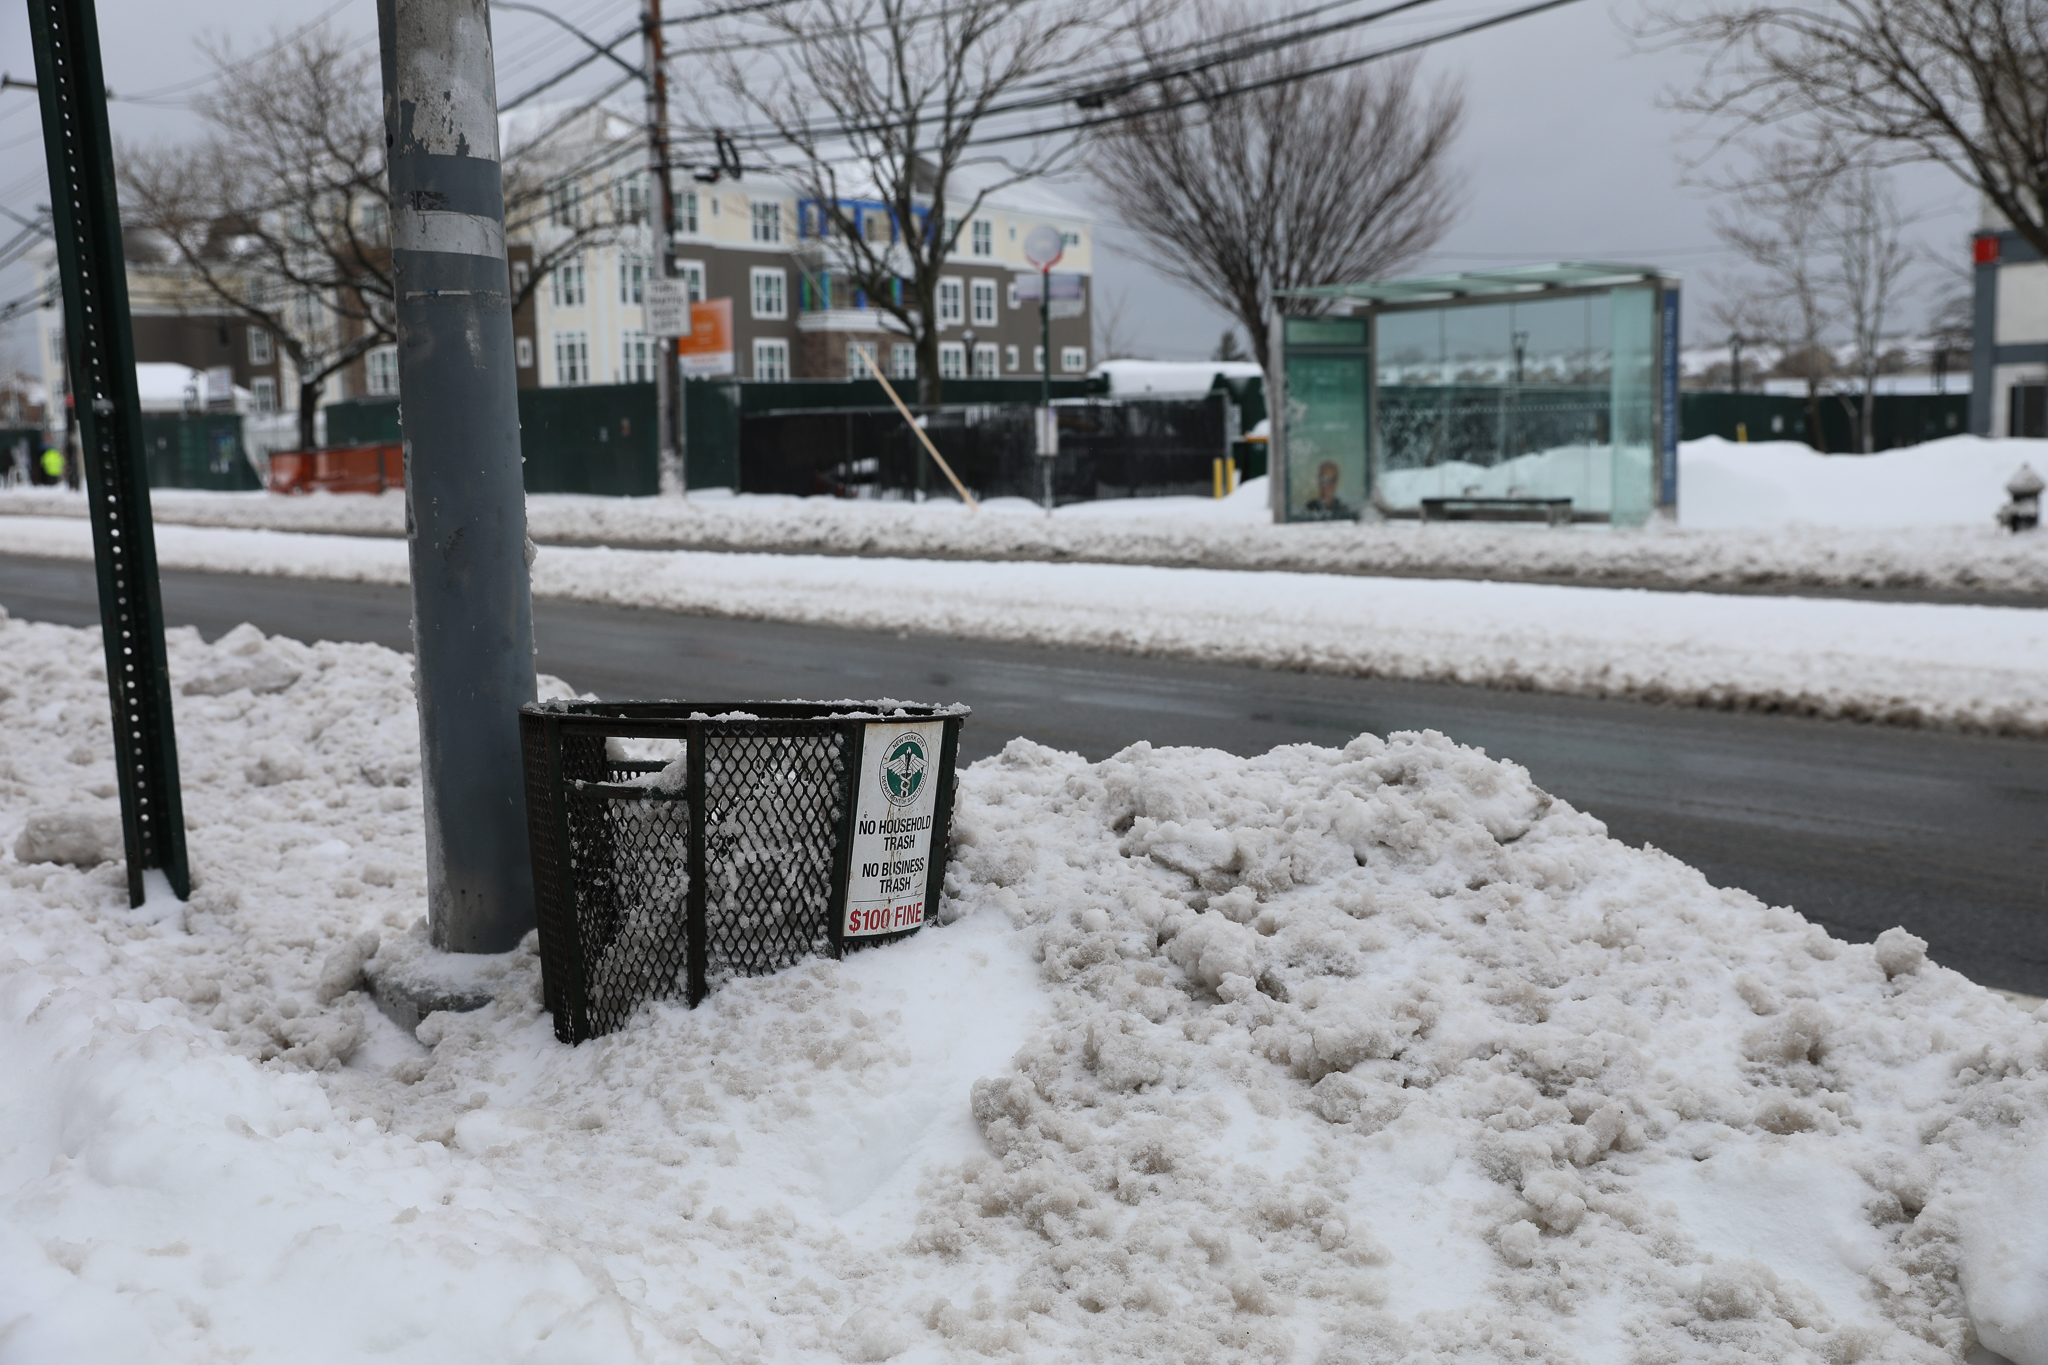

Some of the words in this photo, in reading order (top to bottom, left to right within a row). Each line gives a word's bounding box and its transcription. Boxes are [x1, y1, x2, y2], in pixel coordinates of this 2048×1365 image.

[892, 738, 904, 750] NEW
[904, 734, 917, 742] YORK
[917, 737, 925, 748] CITY
[858, 820, 876, 835] NO
[879, 816, 931, 835] HOUSEHOLD
[884, 835, 915, 851] TRASH
[862, 863, 879, 878] NO
[882, 857, 924, 877] BUSINESS
[879, 876, 911, 894] TRASH
[849, 908, 890, 933] $100
[894, 902, 922, 927] FINE
